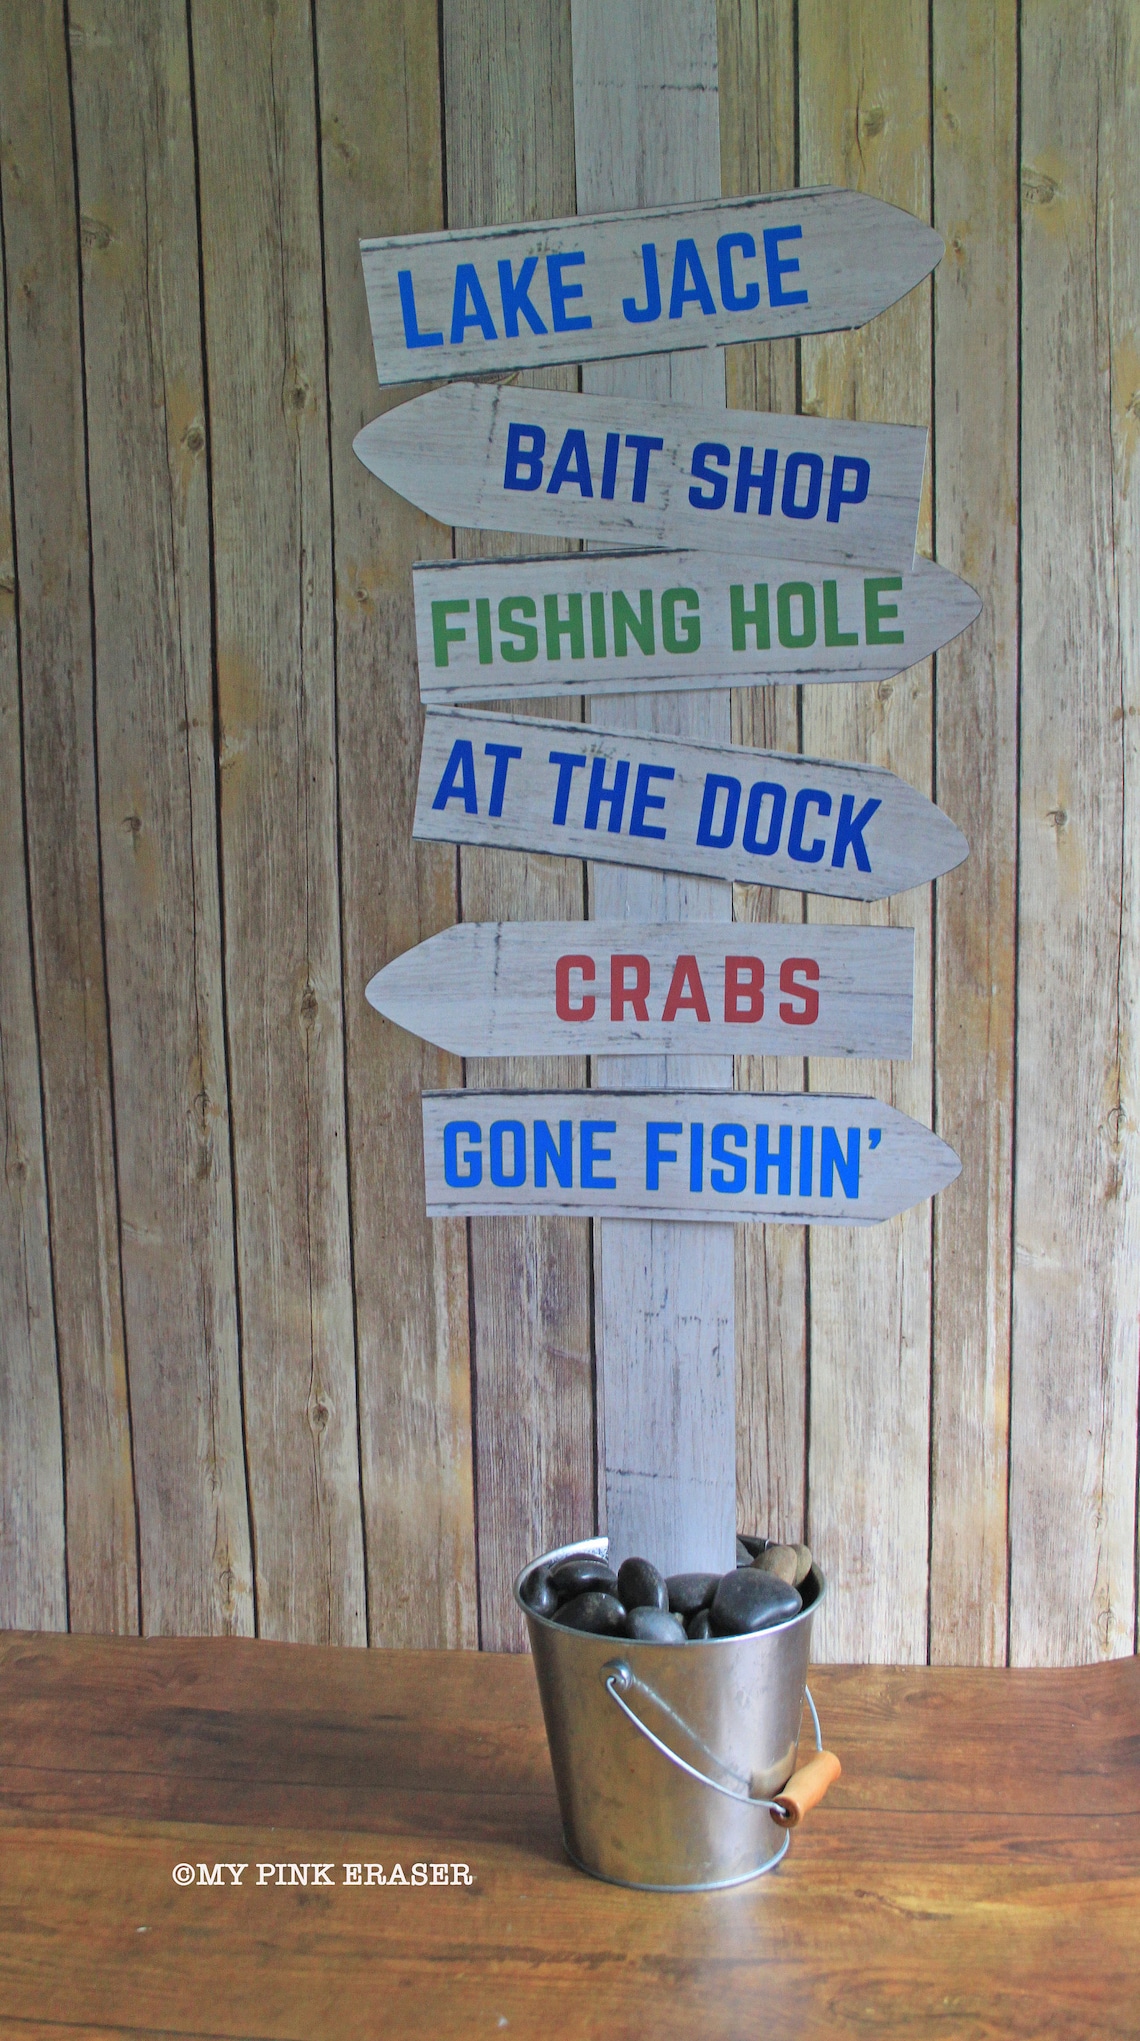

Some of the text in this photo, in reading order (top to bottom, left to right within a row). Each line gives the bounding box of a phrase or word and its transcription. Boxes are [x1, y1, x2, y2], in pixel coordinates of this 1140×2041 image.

[398, 225, 808, 349] LAKE JACE
[503, 422, 870, 523] BAIT SHOP
[431, 577, 904, 667] FISHING HOLE
[432, 739, 882, 872] AT THE DOCK
[555, 954, 819, 1025] CRABS
[443, 1120, 617, 1189] GONE
